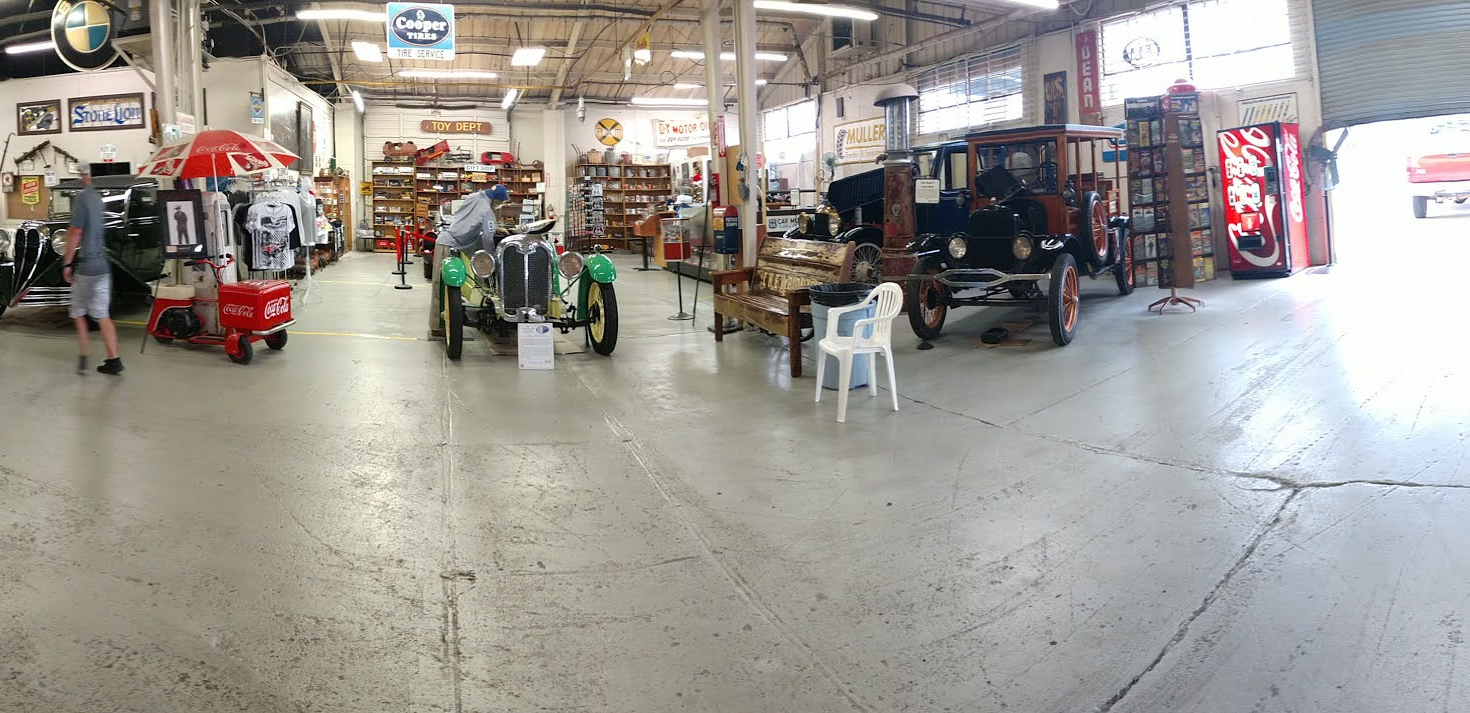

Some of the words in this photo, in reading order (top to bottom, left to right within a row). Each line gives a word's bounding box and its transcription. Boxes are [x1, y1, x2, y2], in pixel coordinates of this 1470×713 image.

[396, 16, 447, 32] Cooper
[407, 32, 437, 40] TIRES
[397, 49, 412, 57] TIRE
[417, 49, 445, 59] SERVICE
[432, 121, 451, 131] TOY
[672, 123, 697, 134] MOTOR
[846, 123, 886, 144] MULLER
[196, 142, 241, 153] Coca-Cola
[223, 303, 254, 318] Coca-Cola
[264, 296, 290, 320] Coca-Cola
